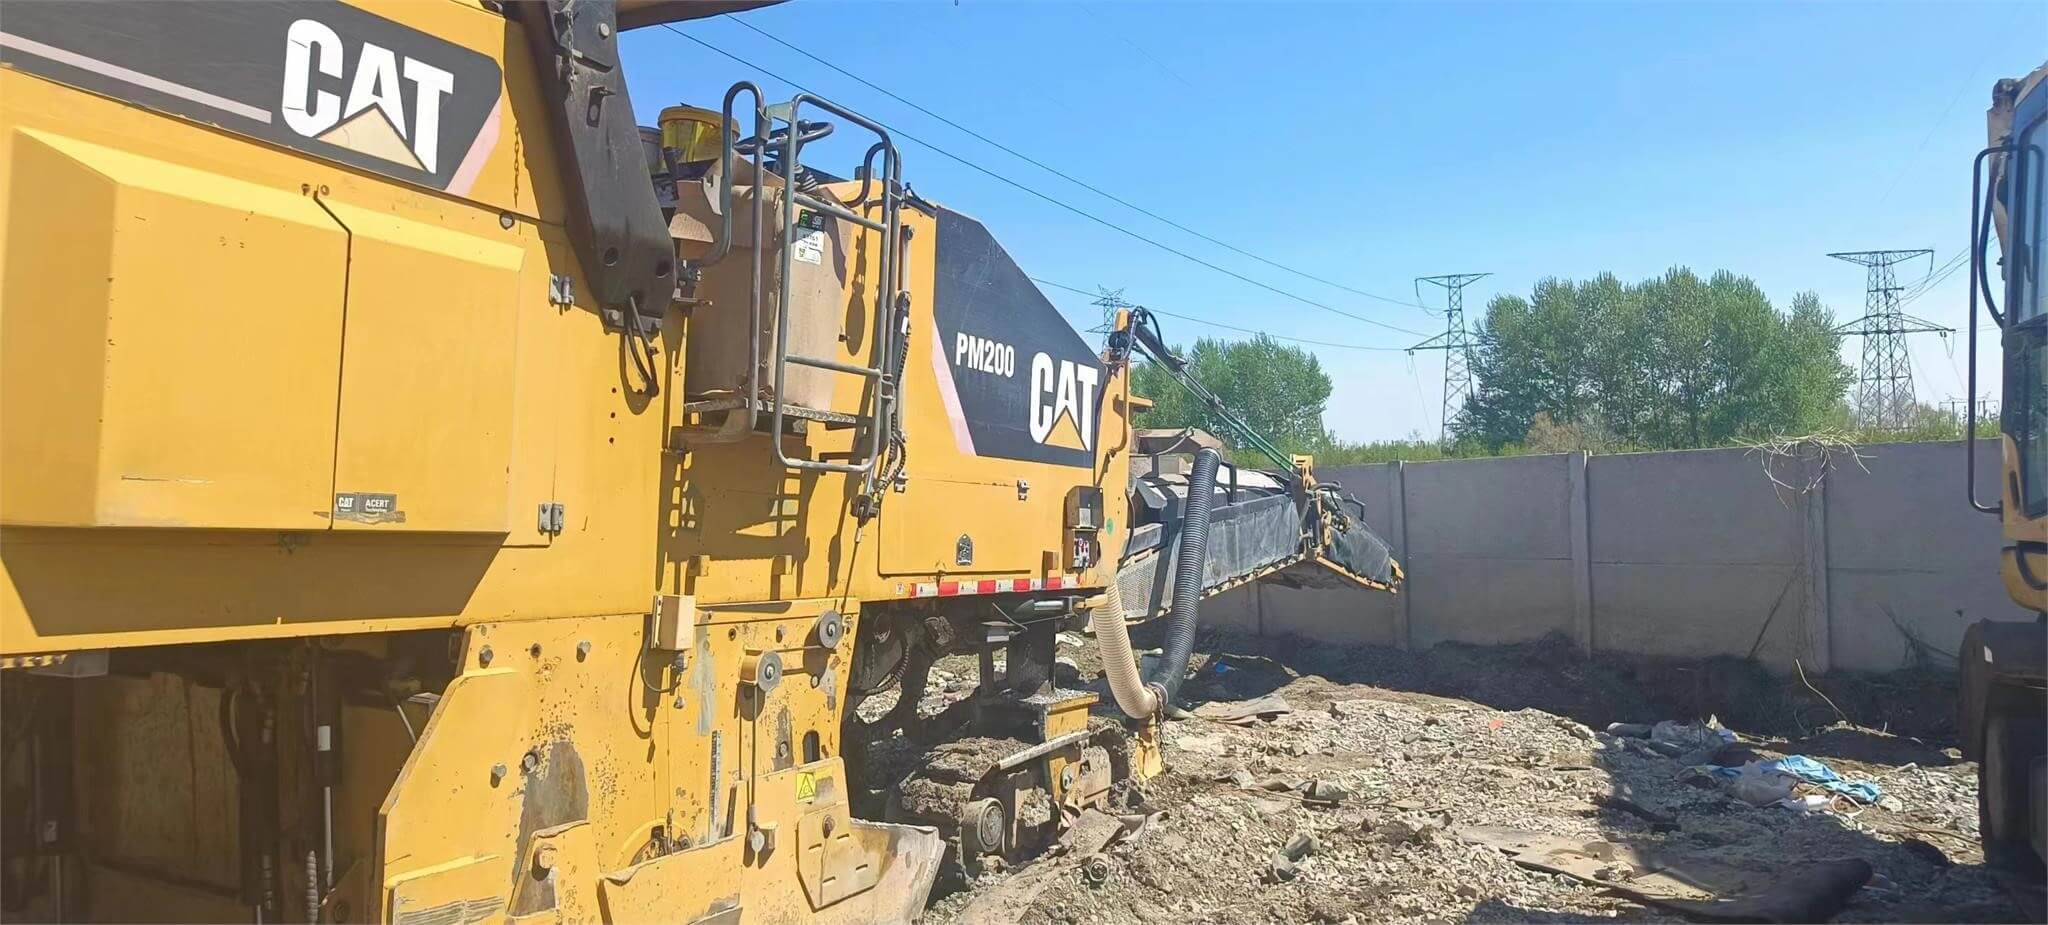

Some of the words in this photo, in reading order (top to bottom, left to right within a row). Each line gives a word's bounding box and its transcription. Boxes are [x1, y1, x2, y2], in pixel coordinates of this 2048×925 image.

[282, 19, 454, 175] CAT
[956, 332, 1015, 378] PM200
[1029, 351, 1098, 452] CAT
[338, 497, 354, 508] CAT
[365, 499, 389, 508] ACERT
